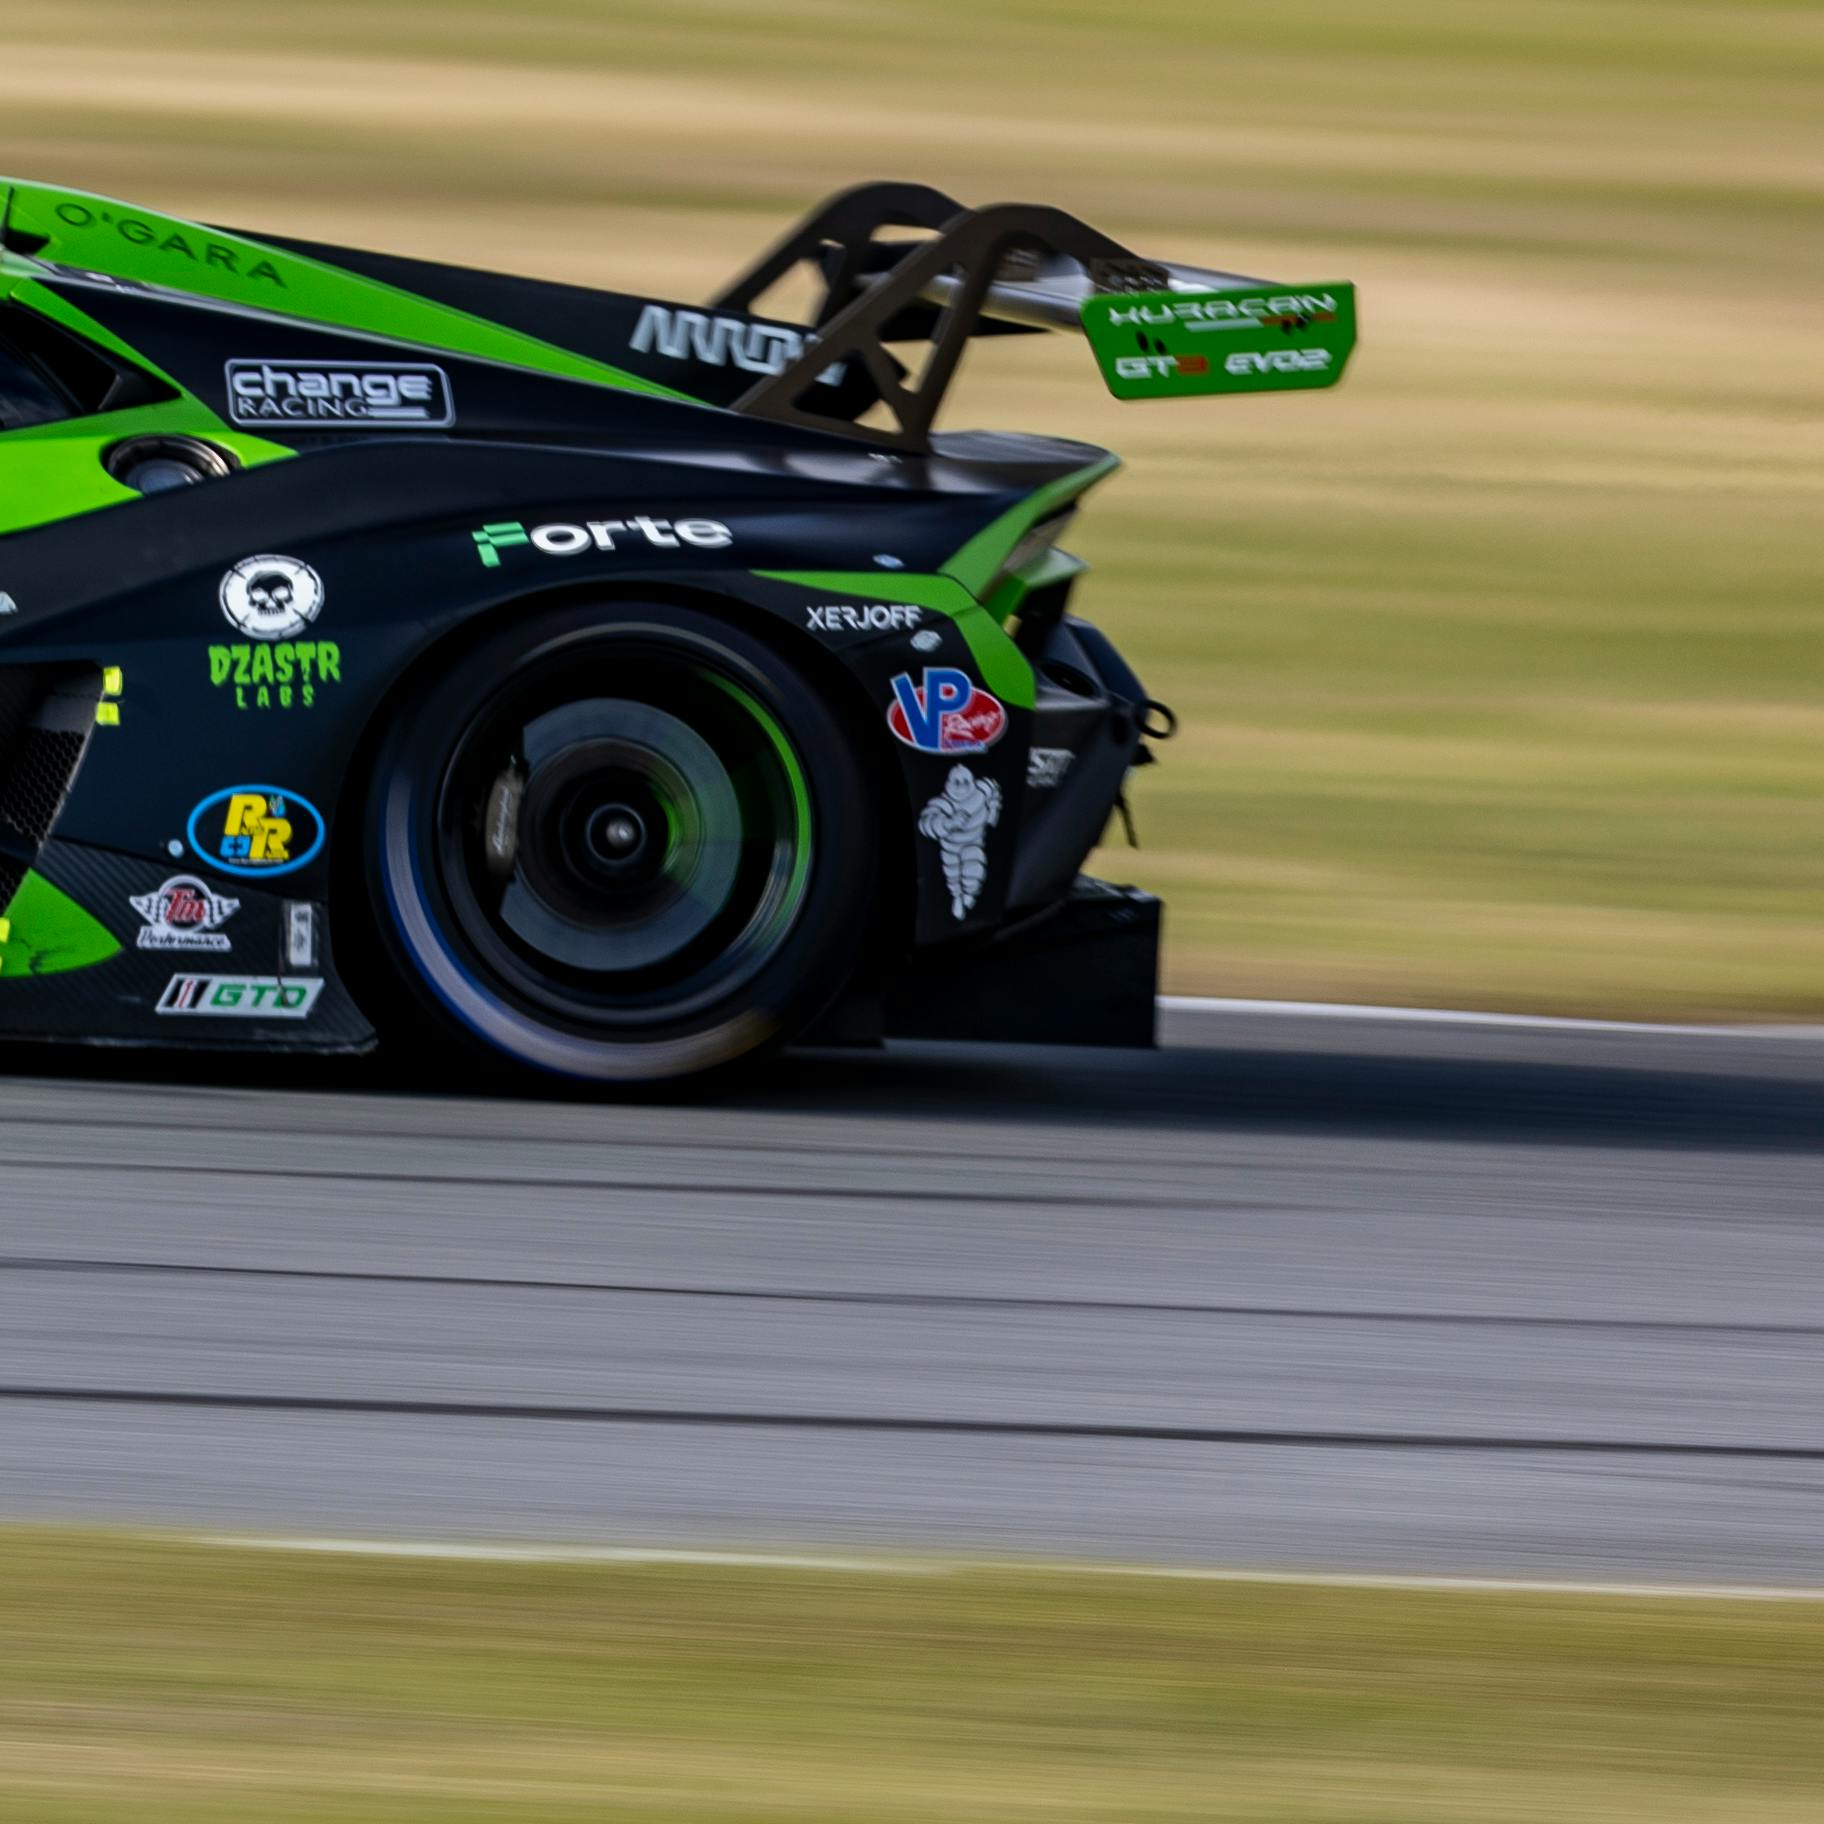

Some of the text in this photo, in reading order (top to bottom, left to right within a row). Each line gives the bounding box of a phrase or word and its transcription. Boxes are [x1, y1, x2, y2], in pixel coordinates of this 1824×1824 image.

[54, 202, 288, 289] O'GARA
[233, 364, 432, 406] change
[236, 396, 370, 418] RACING
[472, 515, 733, 567] Forte
[805, 604, 923, 632] XERJOFF
[207, 640, 342, 687] DZASTR
[236, 685, 317, 710] LABS
[889, 666, 973, 751] VP
[210, 983, 308, 1009] GTD
